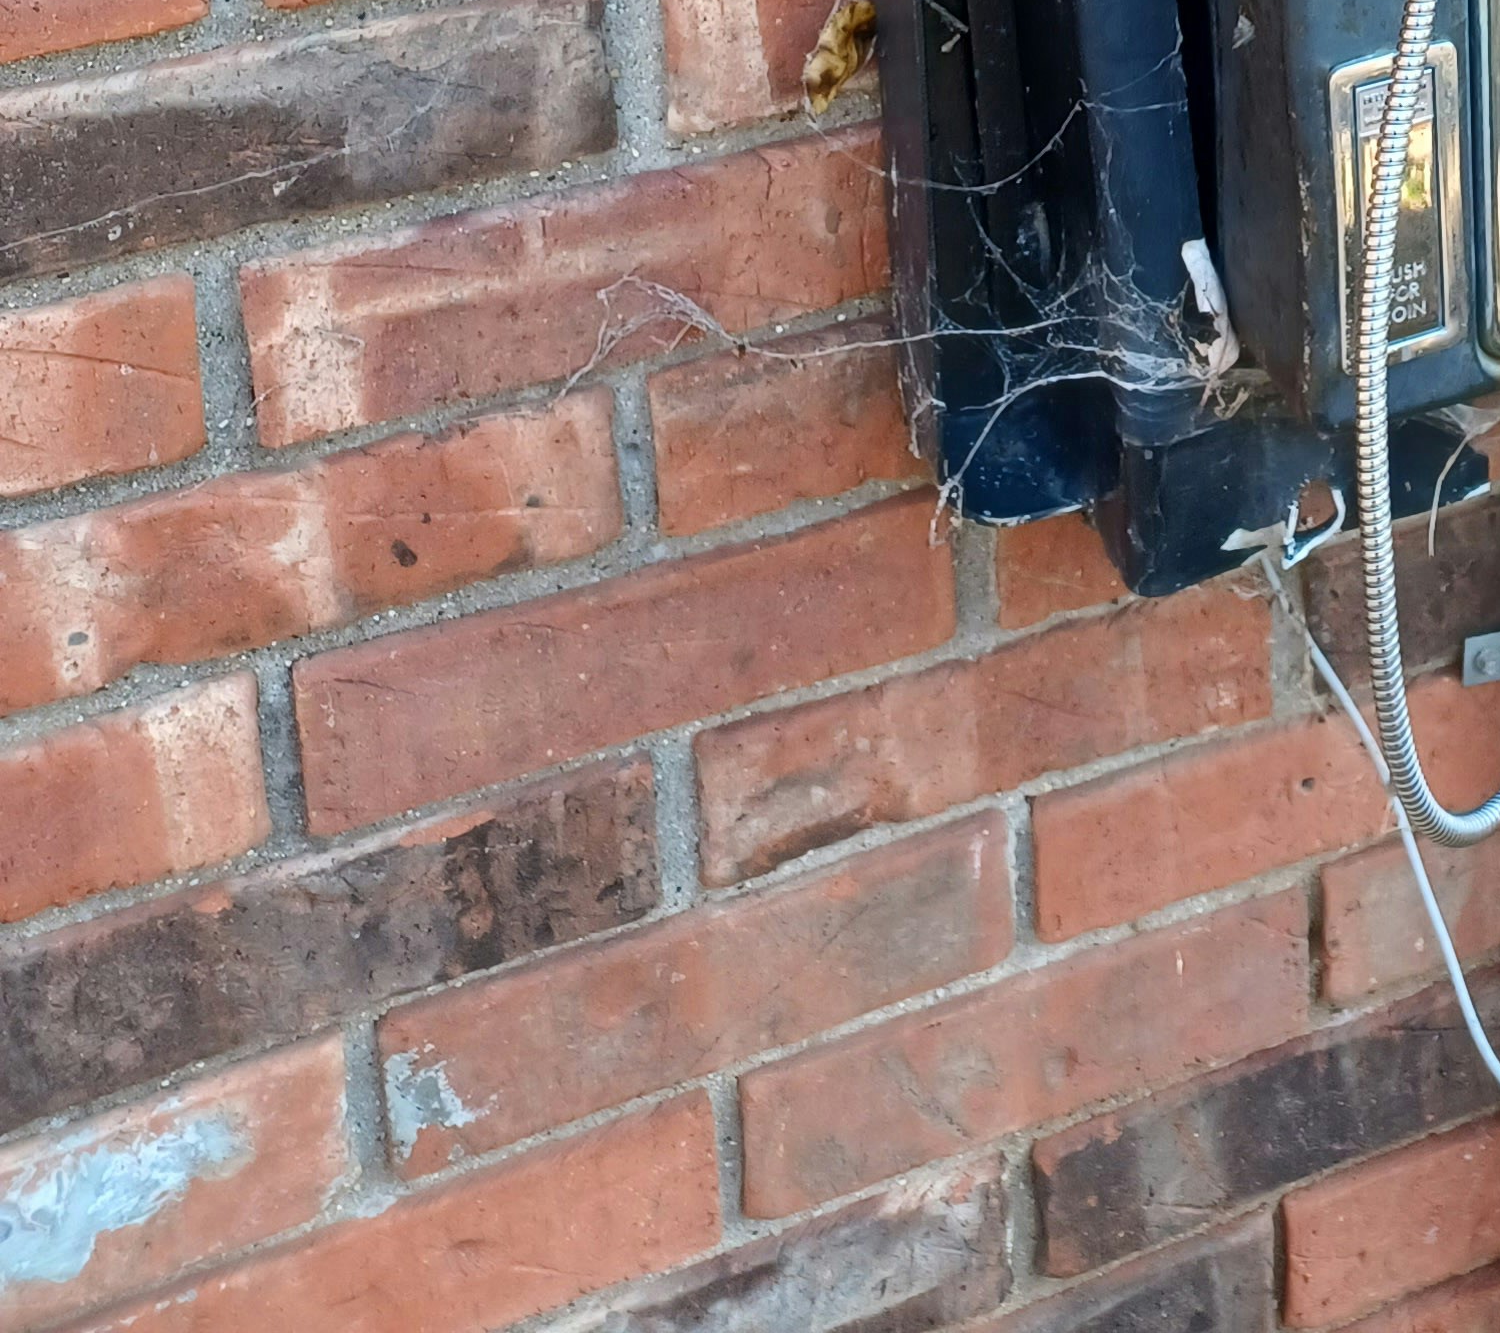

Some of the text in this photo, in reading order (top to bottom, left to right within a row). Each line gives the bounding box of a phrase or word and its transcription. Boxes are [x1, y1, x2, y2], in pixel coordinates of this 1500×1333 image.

[1391, 260, 1427, 284] USH
[1390, 281, 1421, 302] OR
[1391, 299, 1428, 324] OIN
